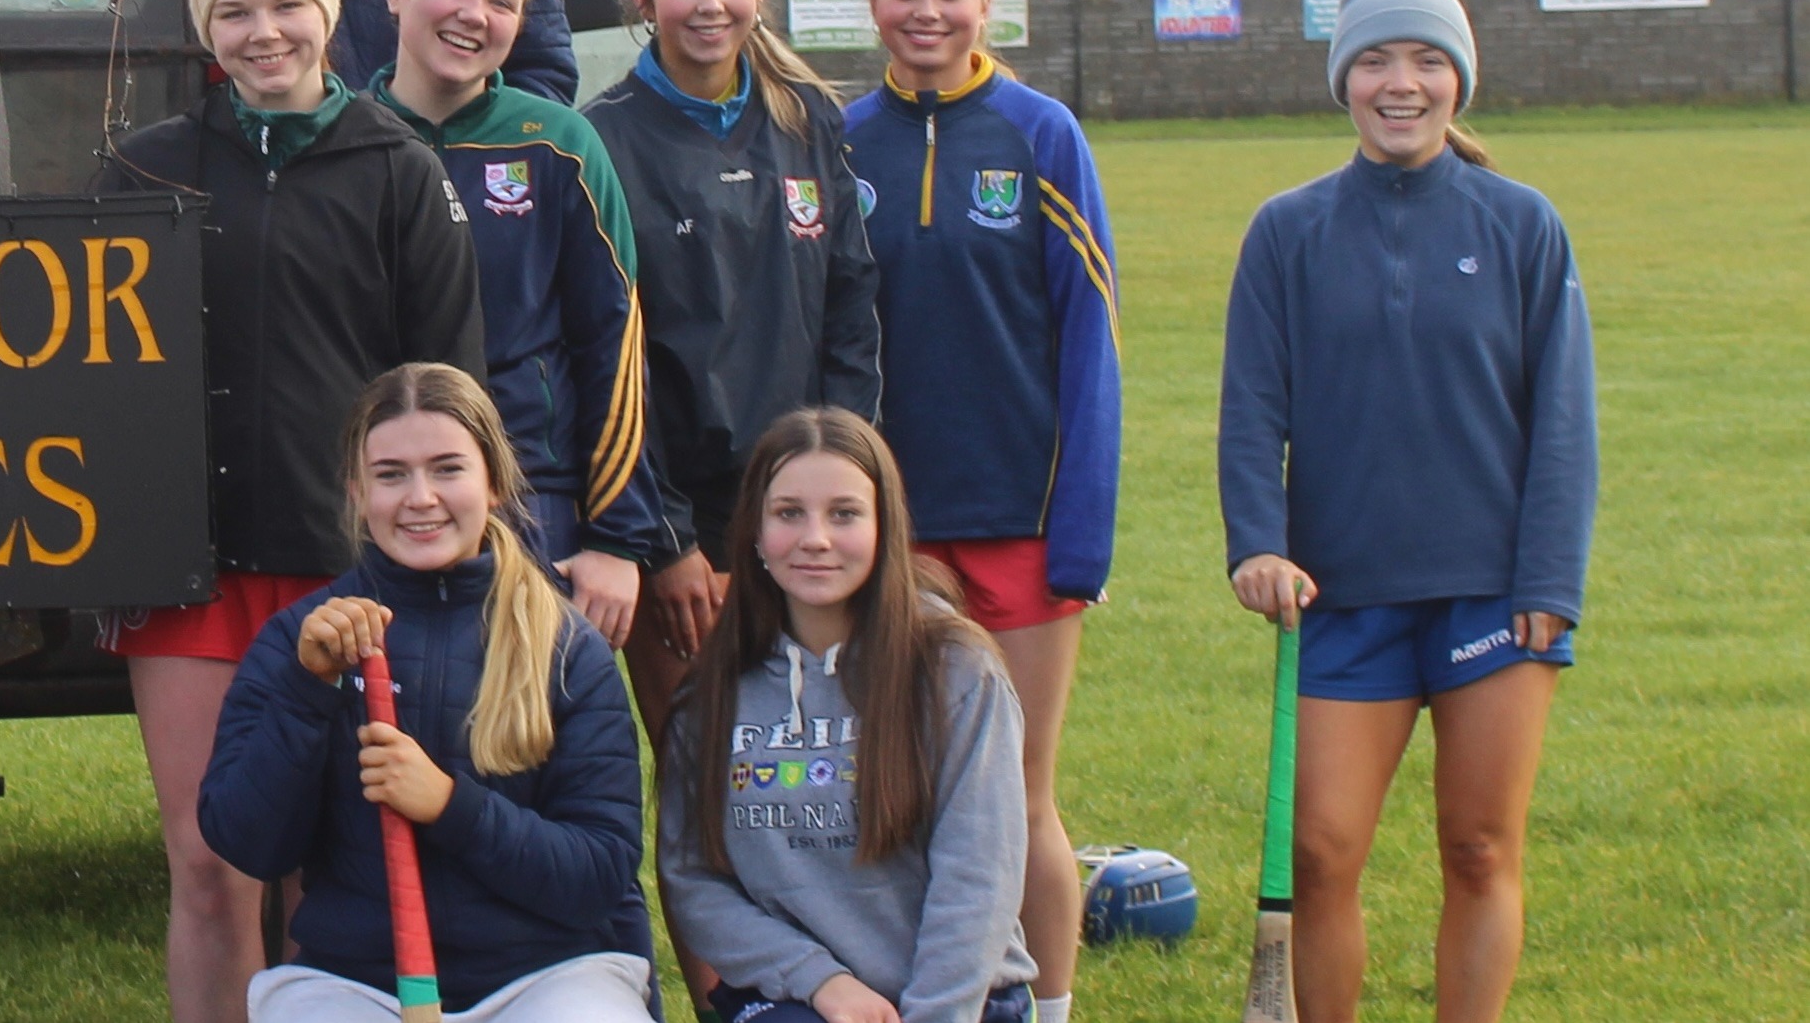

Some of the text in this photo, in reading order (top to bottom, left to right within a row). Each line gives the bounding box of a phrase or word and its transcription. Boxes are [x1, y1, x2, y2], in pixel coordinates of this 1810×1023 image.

[676, 218, 694, 236] AF
[733, 805, 796, 828] PEIL
[802, 802, 847, 828] NA
